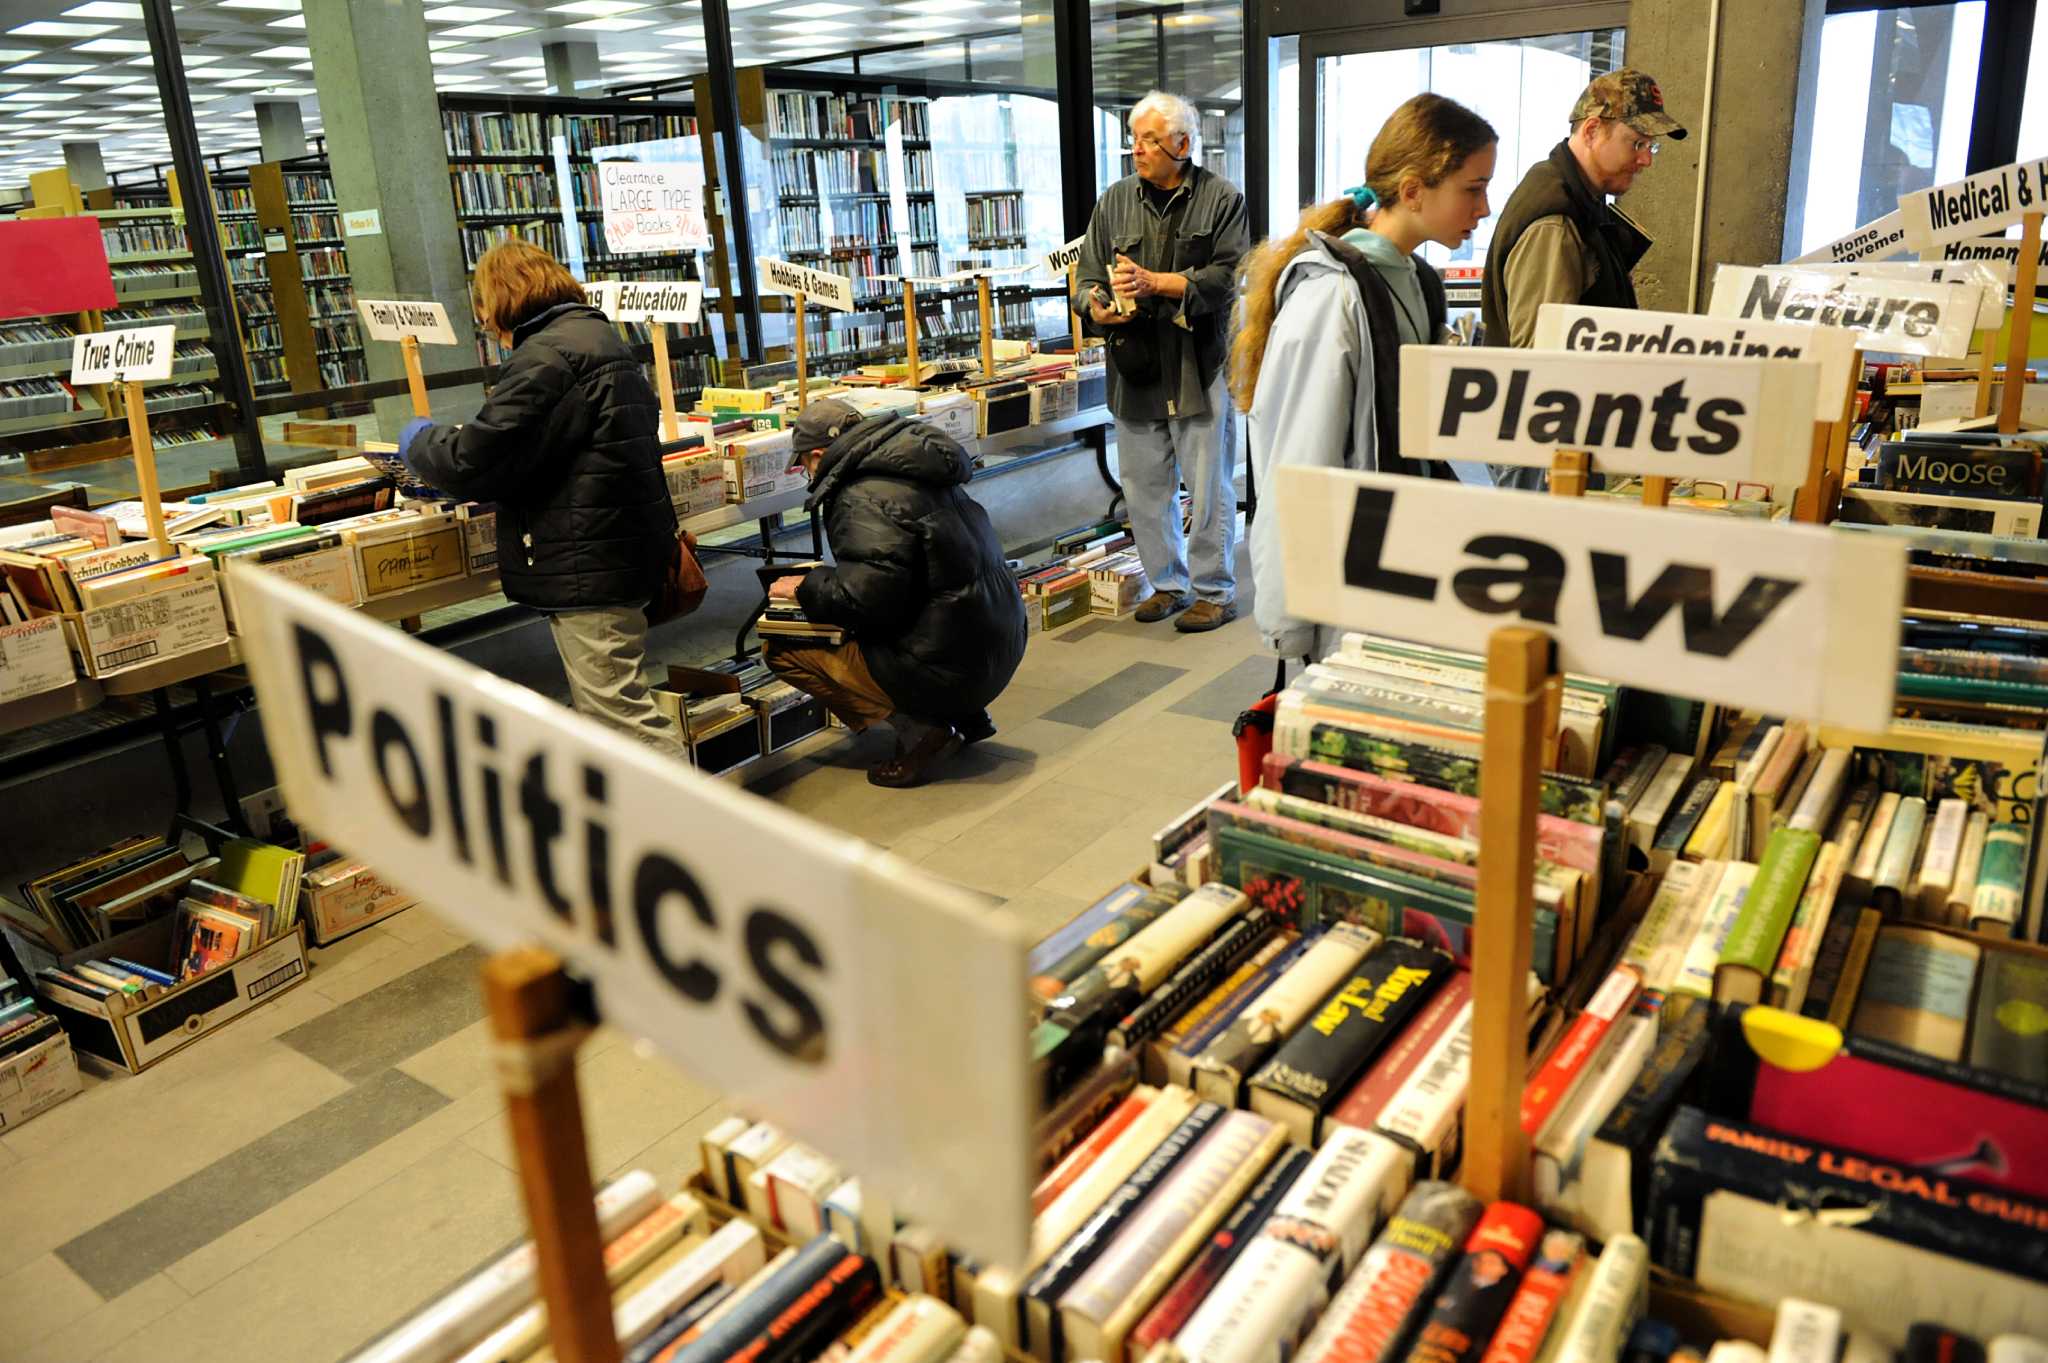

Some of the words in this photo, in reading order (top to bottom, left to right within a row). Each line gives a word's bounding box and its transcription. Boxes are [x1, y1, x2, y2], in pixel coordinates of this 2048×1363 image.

[606, 166, 665, 186] Clearance
[609, 189, 653, 211] LARGE
[662, 189, 692, 210] TYPE
[1928, 172, 2010, 231] Medical
[2018, 166, 2032, 207] &
[636, 213, 673, 233] Books
[1831, 228, 1879, 258] Home
[618, 285, 688, 311] Education
[770, 263, 802, 290] Hobbies
[804, 272, 810, 292] &
[812, 273, 839, 300] Games
[370, 304, 399, 331] Family
[403, 305, 438, 327] Children
[1740, 274, 1940, 339] Nature
[82, 338, 110, 371] True
[114, 333, 155, 368] Crime
[1438, 366, 1747, 456] Plants
[1896, 454, 2007, 486] Moose
[104, 551, 150, 573] Cookbook
[1343, 486, 1807, 660] Law
[290, 619, 834, 1068] Politics
[1374, 964, 1432, 1003] You
[1311, 991, 1370, 1037] Law
[1704, 1123, 1813, 1165] FAMILY
[1817, 1151, 1960, 1208] LEGAL
